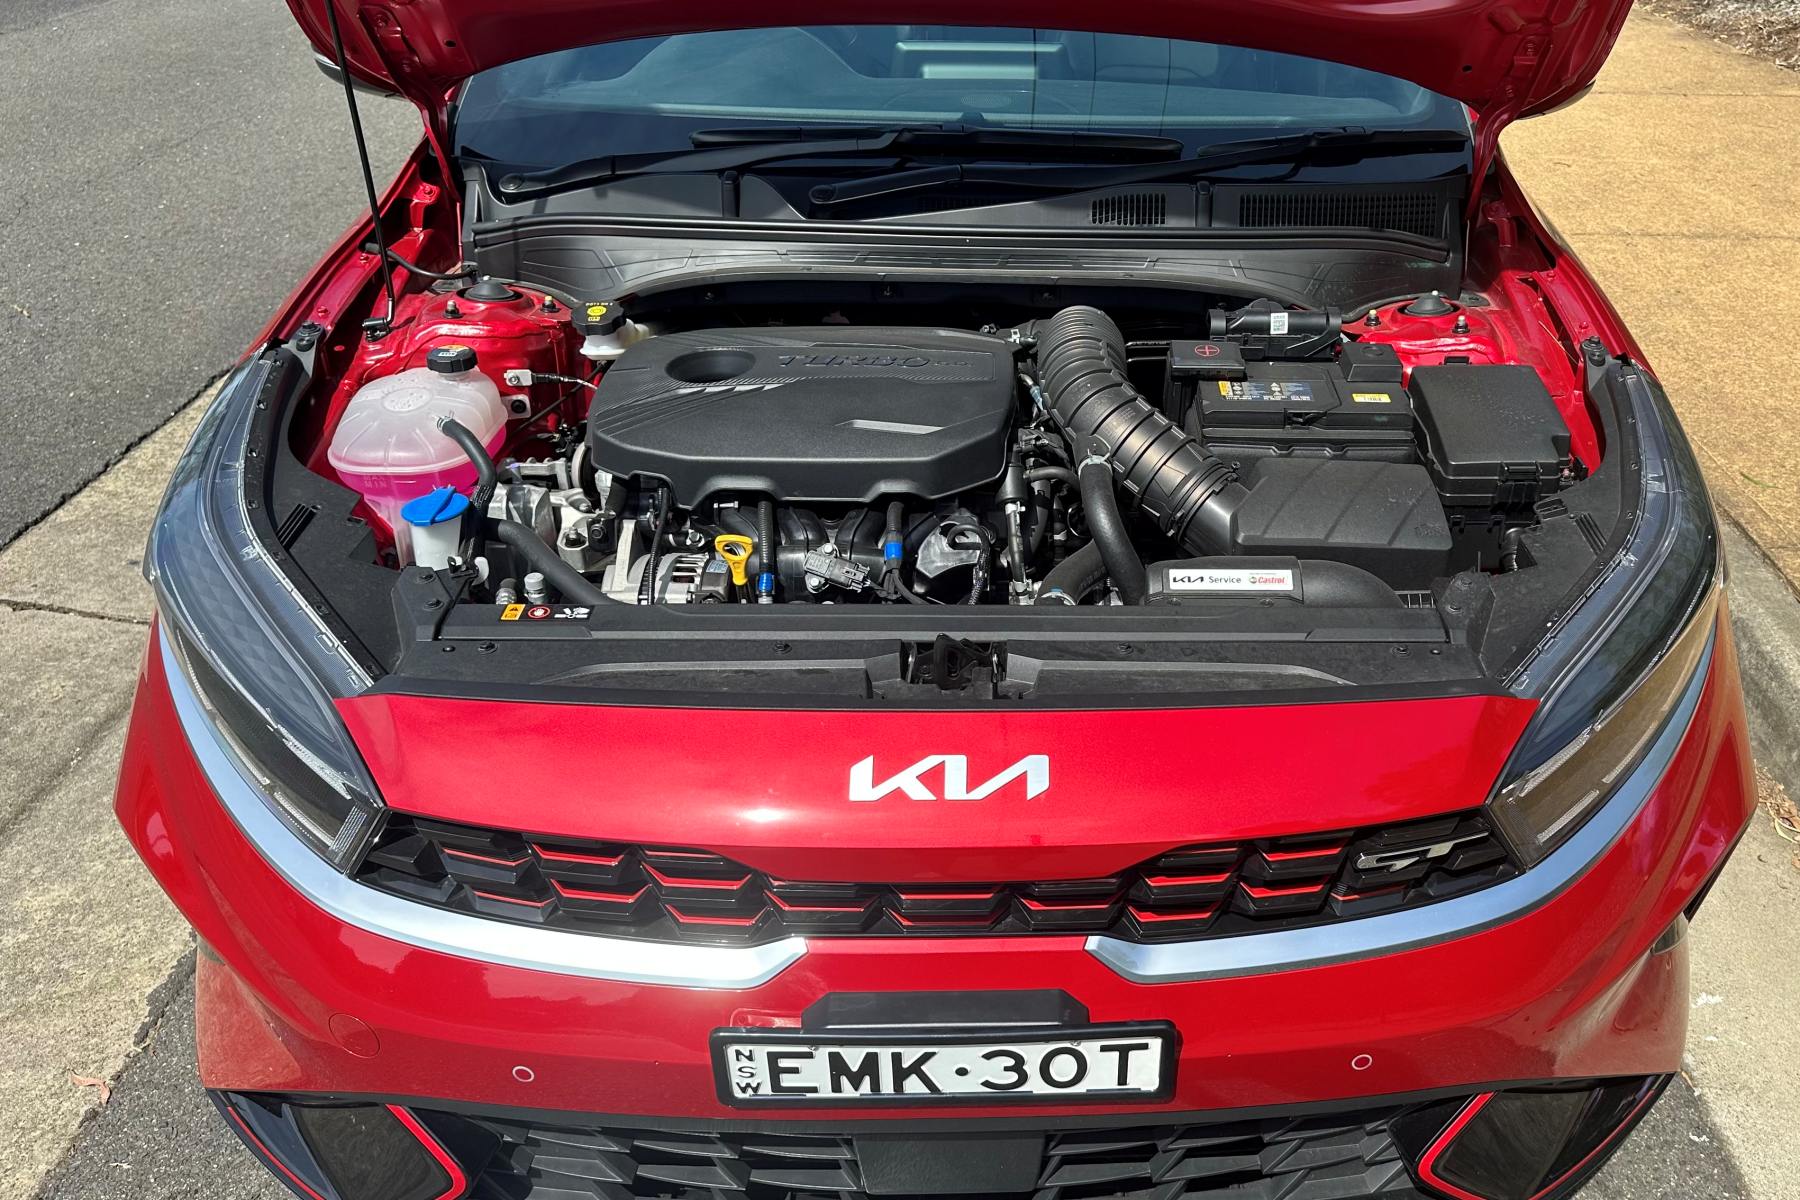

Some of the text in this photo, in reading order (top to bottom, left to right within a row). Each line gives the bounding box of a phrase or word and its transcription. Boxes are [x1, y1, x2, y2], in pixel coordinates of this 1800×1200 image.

[778, 355, 930, 368] TURBO
[1208, 576, 1242, 584] Service
[1257, 576, 1285, 584] Castrol
[848, 754, 1050, 802] KIA
[1356, 832, 1490, 873] GT
